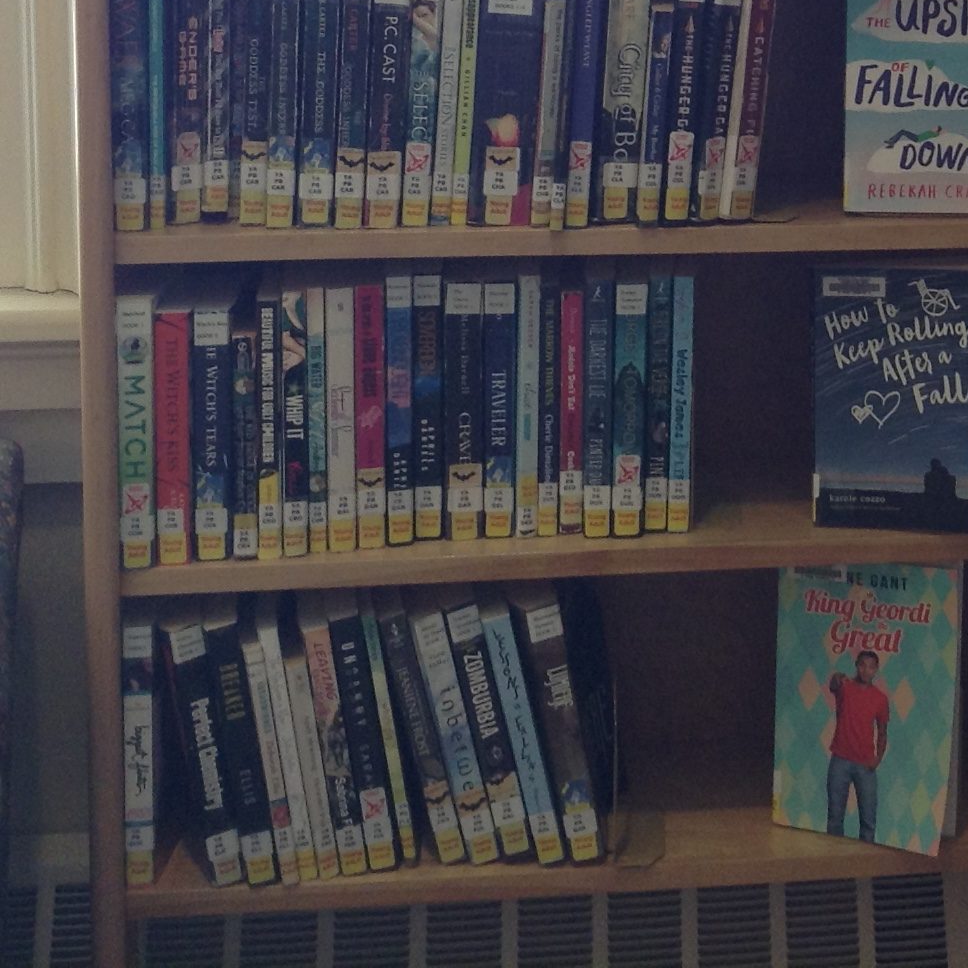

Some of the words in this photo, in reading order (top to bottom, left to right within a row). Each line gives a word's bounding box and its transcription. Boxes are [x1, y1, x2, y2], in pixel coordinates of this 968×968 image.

[383, 16, 398, 41] P.C.
[866, 17, 891, 28] THE
[179, 31, 188, 87] GAME
[187, 16, 199, 100] ENDER'S
[382, 44, 397, 83] CAST
[748, 36, 764, 112] CATCHING
[891, 62, 910, 72] OF
[439, 53, 455, 126] SELECTION
[462, 69, 471, 108] GILLIAN
[679, 55, 694, 114] HUNGER
[715, 54, 732, 114] HUNGER
[314, 80, 324, 133] GODDESS
[460, 112, 469, 138] CHAN
[867, 184, 937, 200] REBEKAH
[589, 319, 607, 337] THE
[824, 306, 869, 340] How
[874, 298, 899, 324] To
[166, 338, 180, 367] THE
[589, 340, 606, 381] DARKEST
[674, 349, 688, 394] Wesley
[834, 335, 886, 370] Keep
[882, 349, 934, 386] After
[938, 350, 953, 365] a
[167, 370, 181, 436] WITCH'S
[206, 365, 218, 422] WITCH'S
[286, 394, 303, 425] WHIP
[491, 372, 507, 446] TRAVELER
[589, 385, 606, 399] LIE
[125, 375, 146, 478] MATCH
[286, 428, 303, 440] IT
[544, 414, 555, 442] Cherie
[674, 397, 687, 439] James
[167, 440, 181, 472] KISS
[206, 428, 218, 467] TEARS
[458, 412, 472, 464] CRAVE
[870, 573, 908, 591] GANT
[804, 589, 855, 622] King
[860, 597, 932, 624] Geordi
[831, 620, 904, 654] Great
[463, 651, 499, 739] ZOMBURBIA
